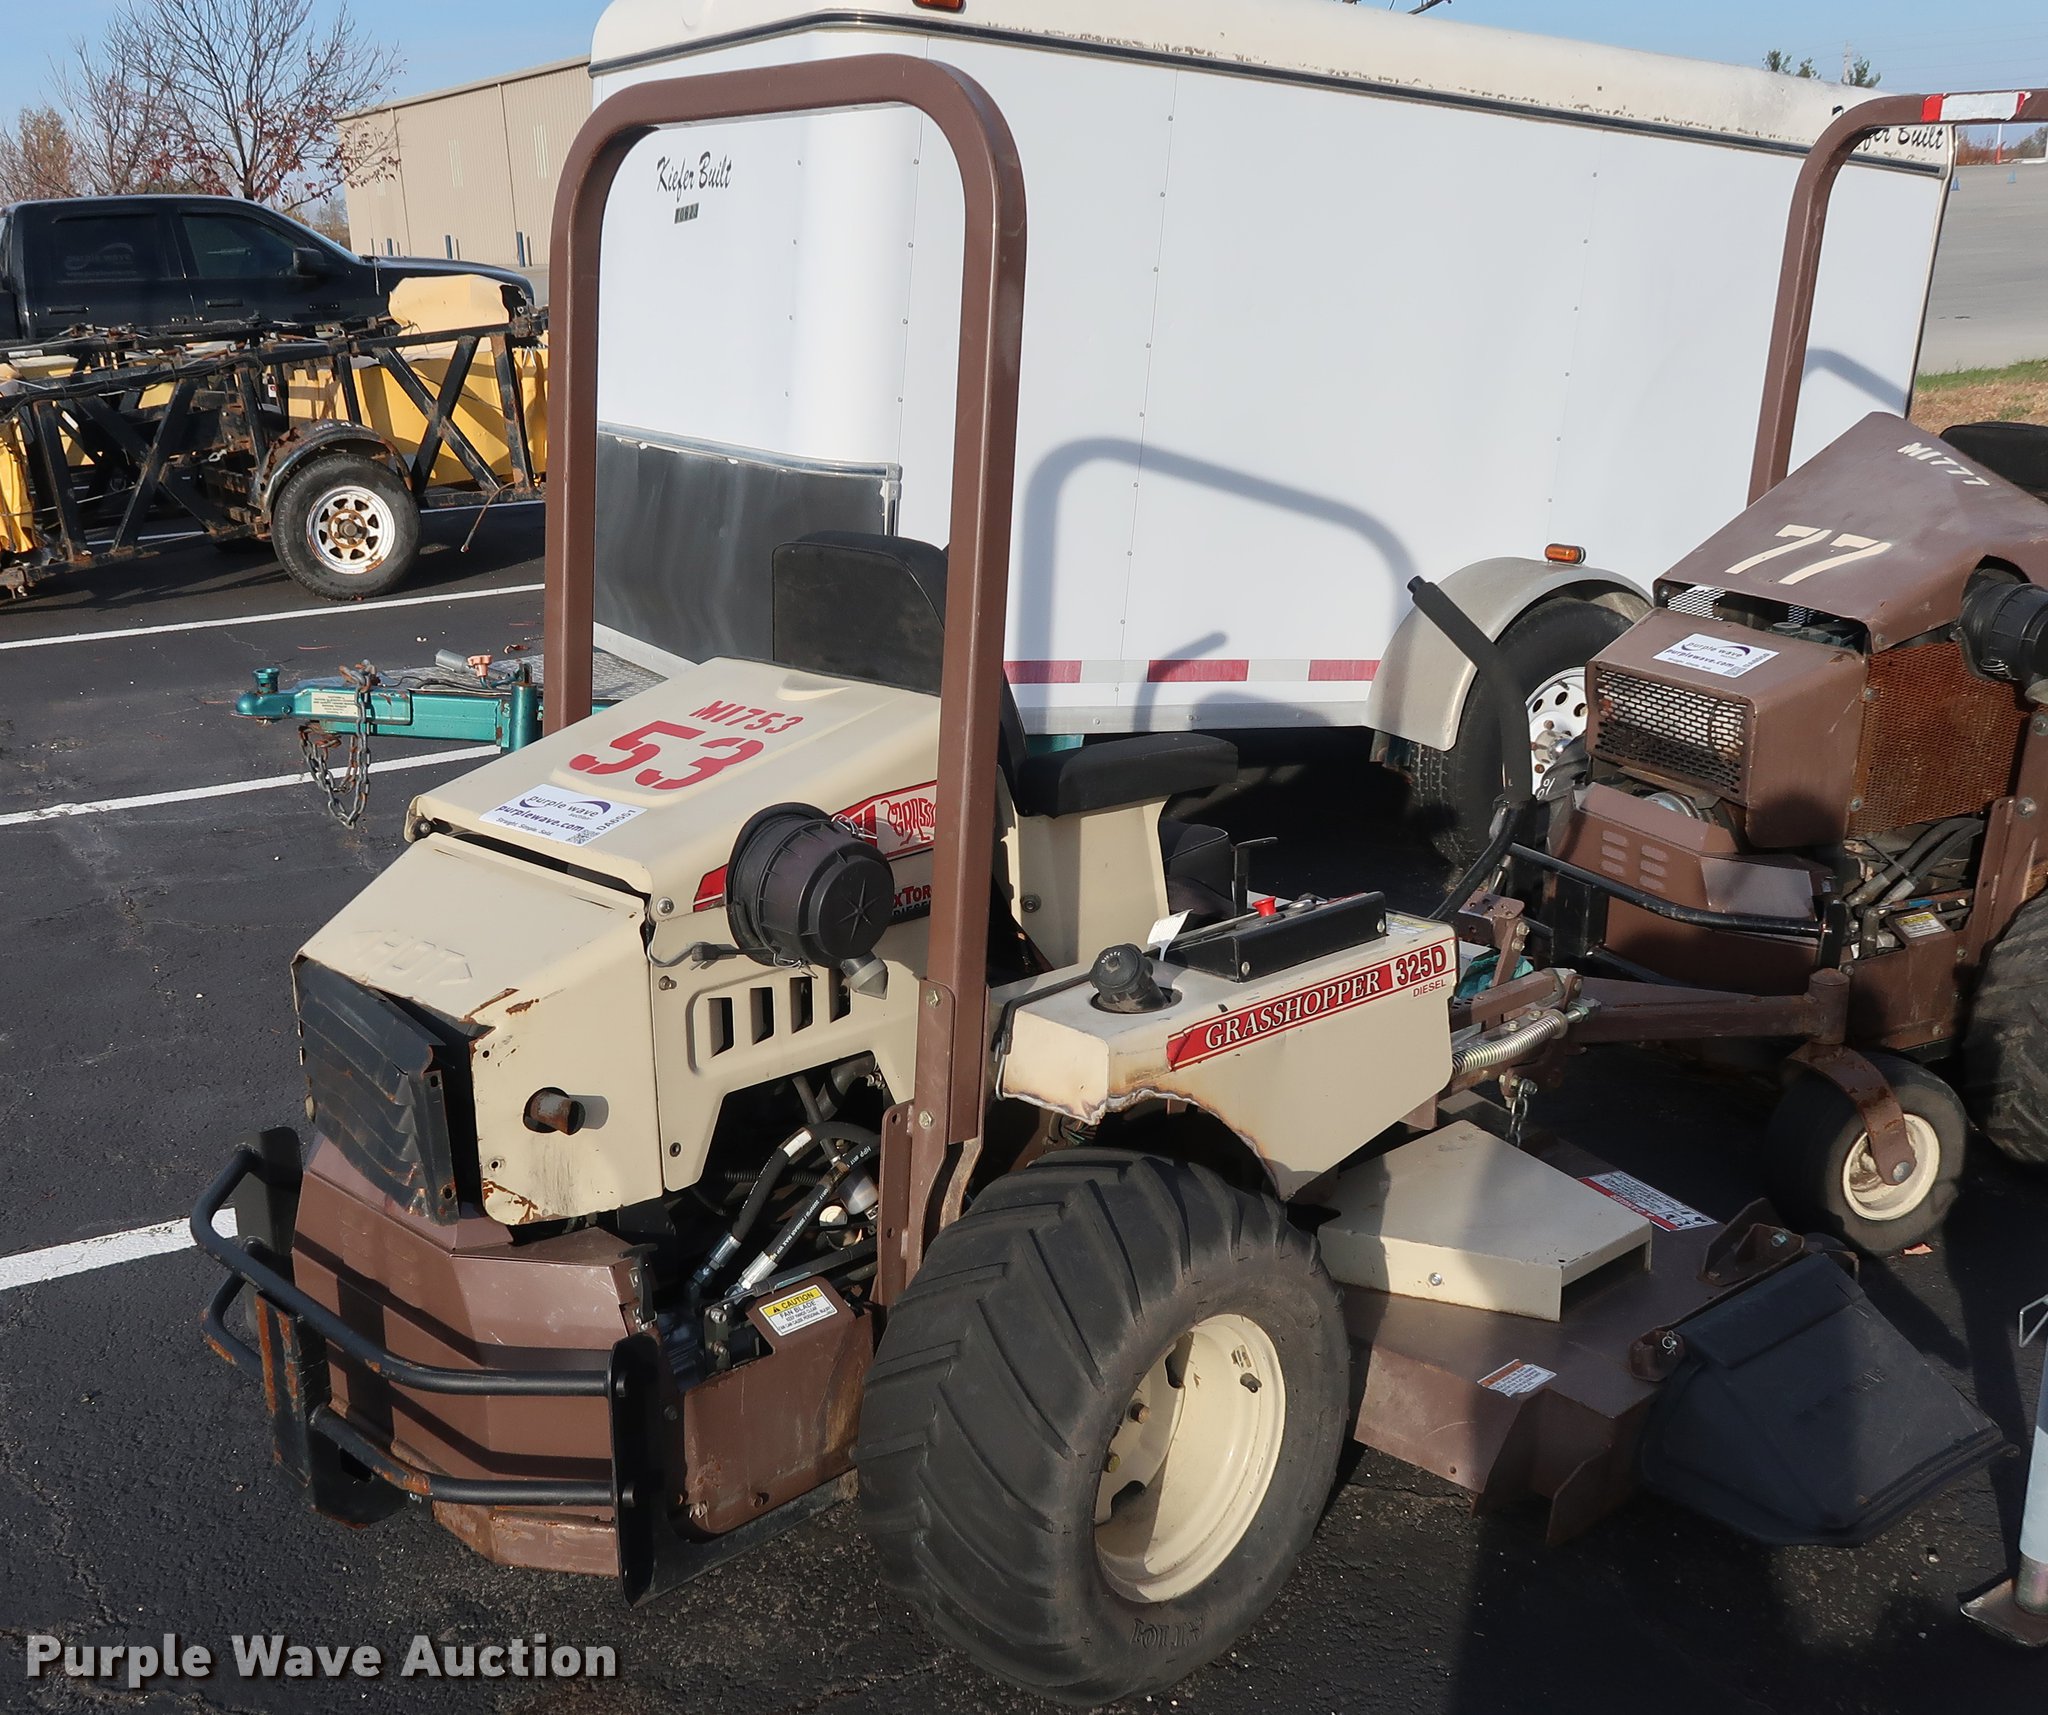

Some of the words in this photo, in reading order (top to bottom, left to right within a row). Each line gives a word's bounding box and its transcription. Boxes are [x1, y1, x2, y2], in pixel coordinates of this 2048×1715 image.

[656, 156, 695, 203] Kiefer
[699, 151, 732, 189] Built
[1724, 524, 1893, 585] 77
[569, 720, 764, 790] 53
[495, 805, 584, 832] purplewave.com
[528, 795, 567, 810] purple
[568, 804, 600, 818] wave
[1205, 969, 1381, 1051] GRASSHOPPER
[1396, 945, 1448, 986] 325D
[1412, 979, 1447, 998] DIESEL
[780, 1310, 794, 1319] FAN
[793, 1300, 817, 1312] BLADE
[781, 1292, 815, 1309] CAUTION
